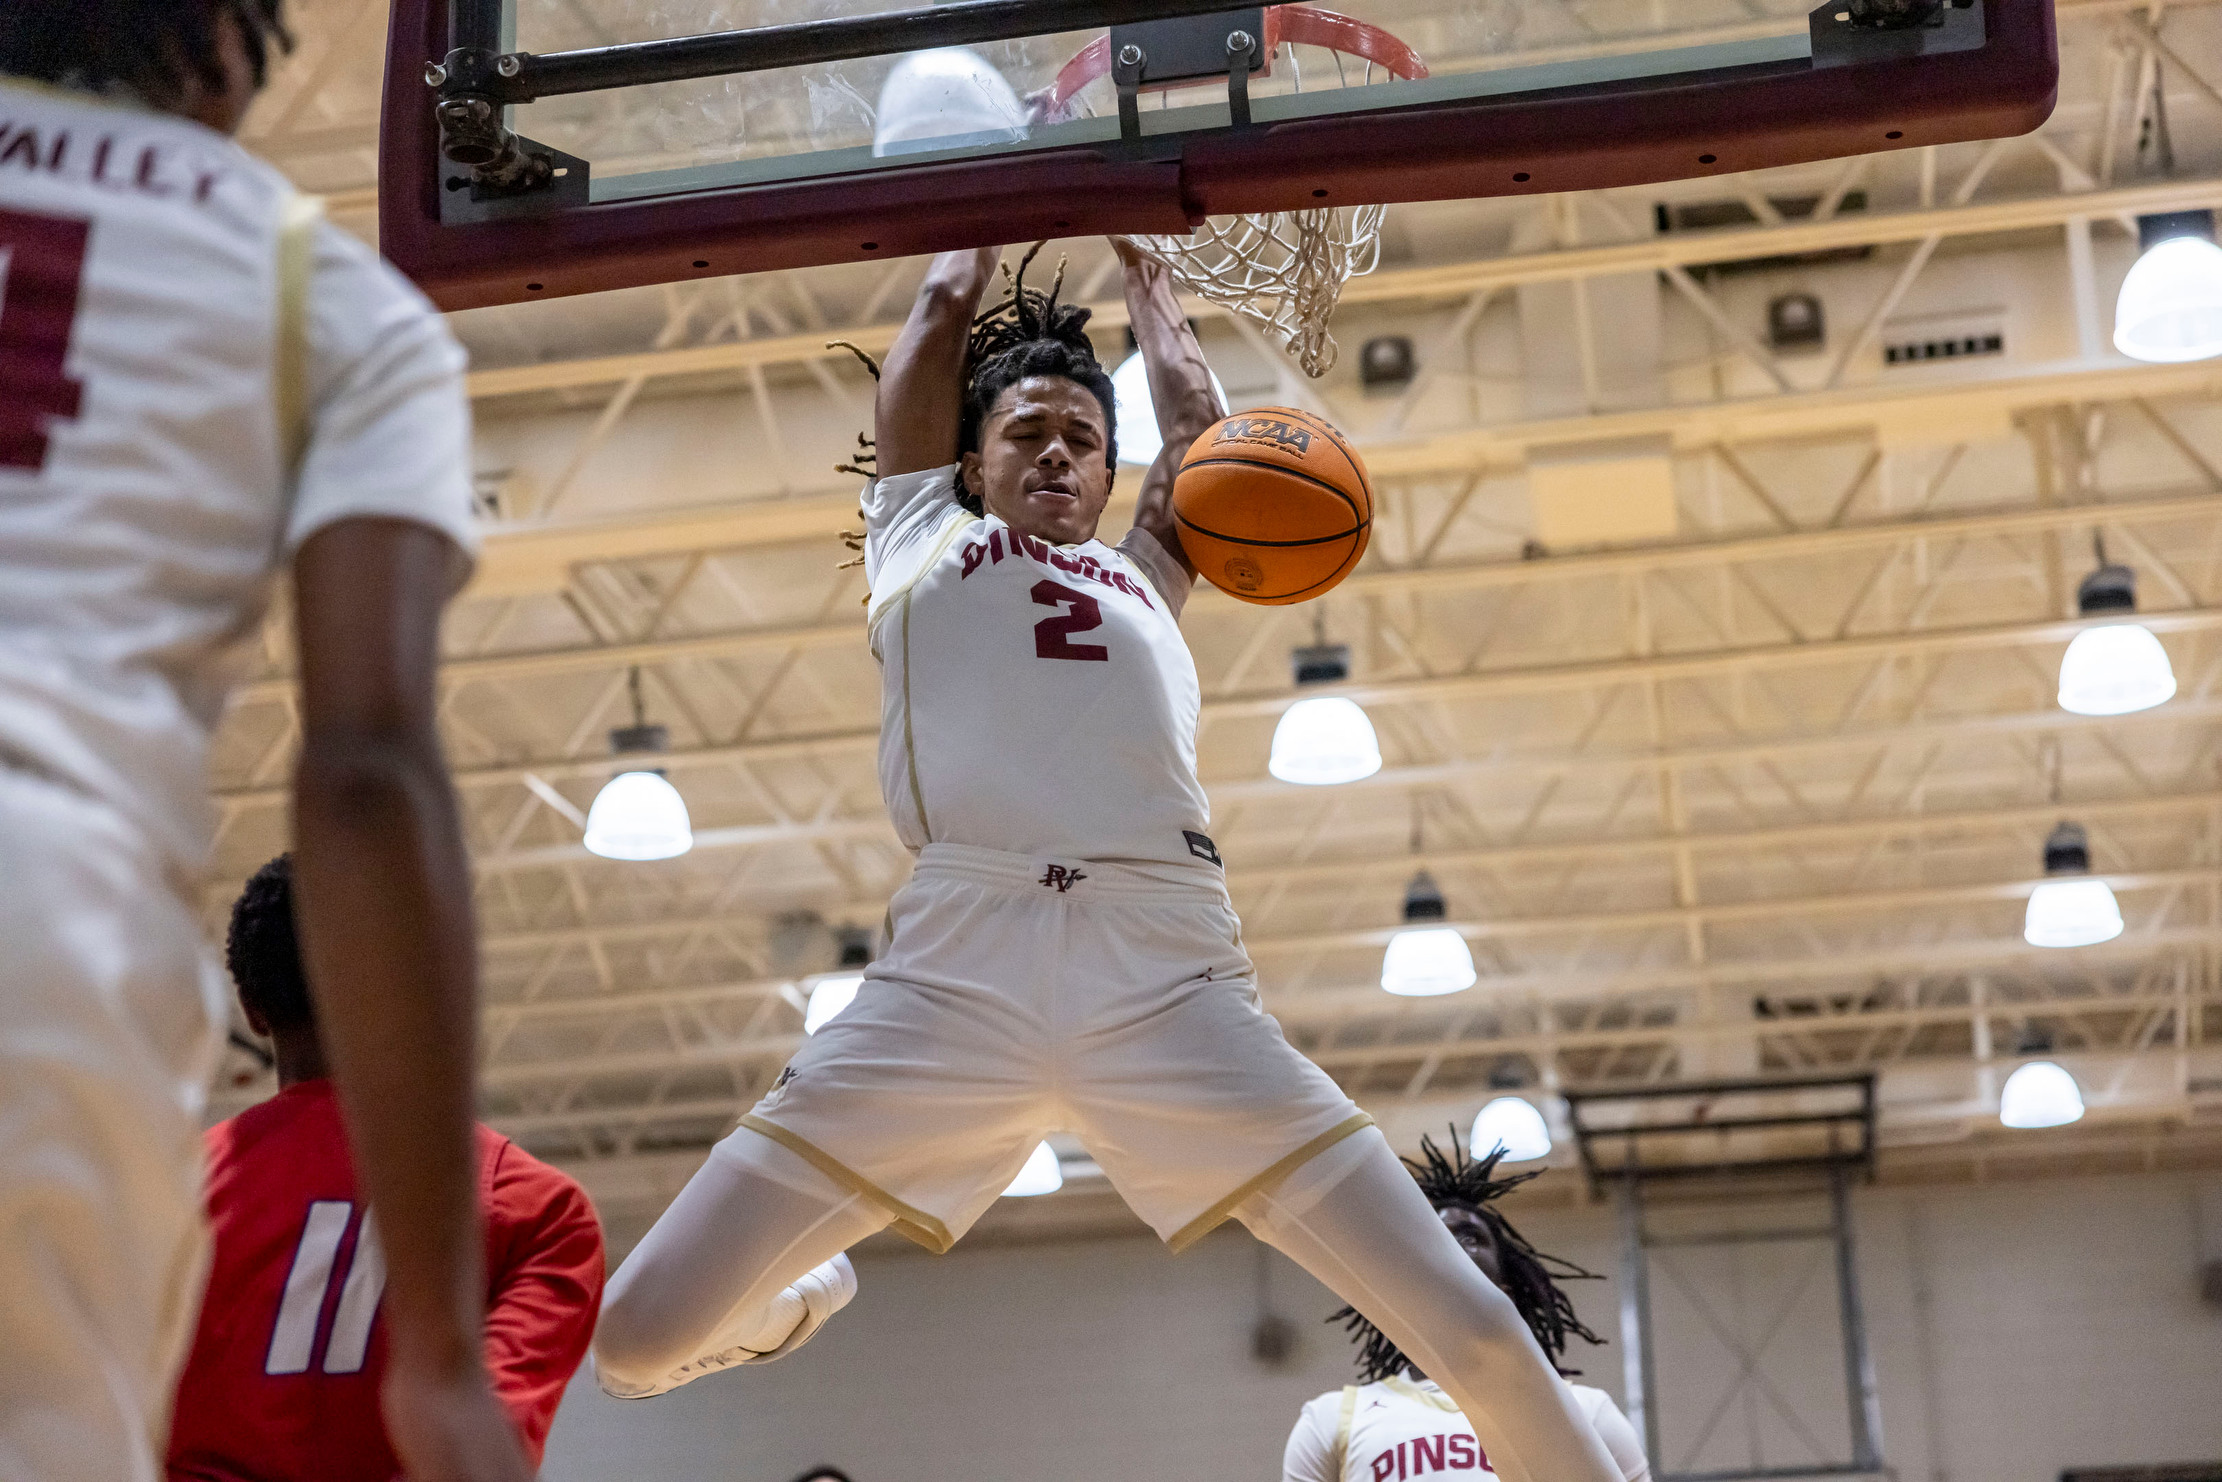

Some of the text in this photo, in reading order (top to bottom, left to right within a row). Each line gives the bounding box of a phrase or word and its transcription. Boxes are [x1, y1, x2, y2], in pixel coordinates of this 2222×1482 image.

[1214, 418, 1312, 454] NCAA
[1030, 579, 1108, 661] 2
[265, 1201, 388, 1375] 11
